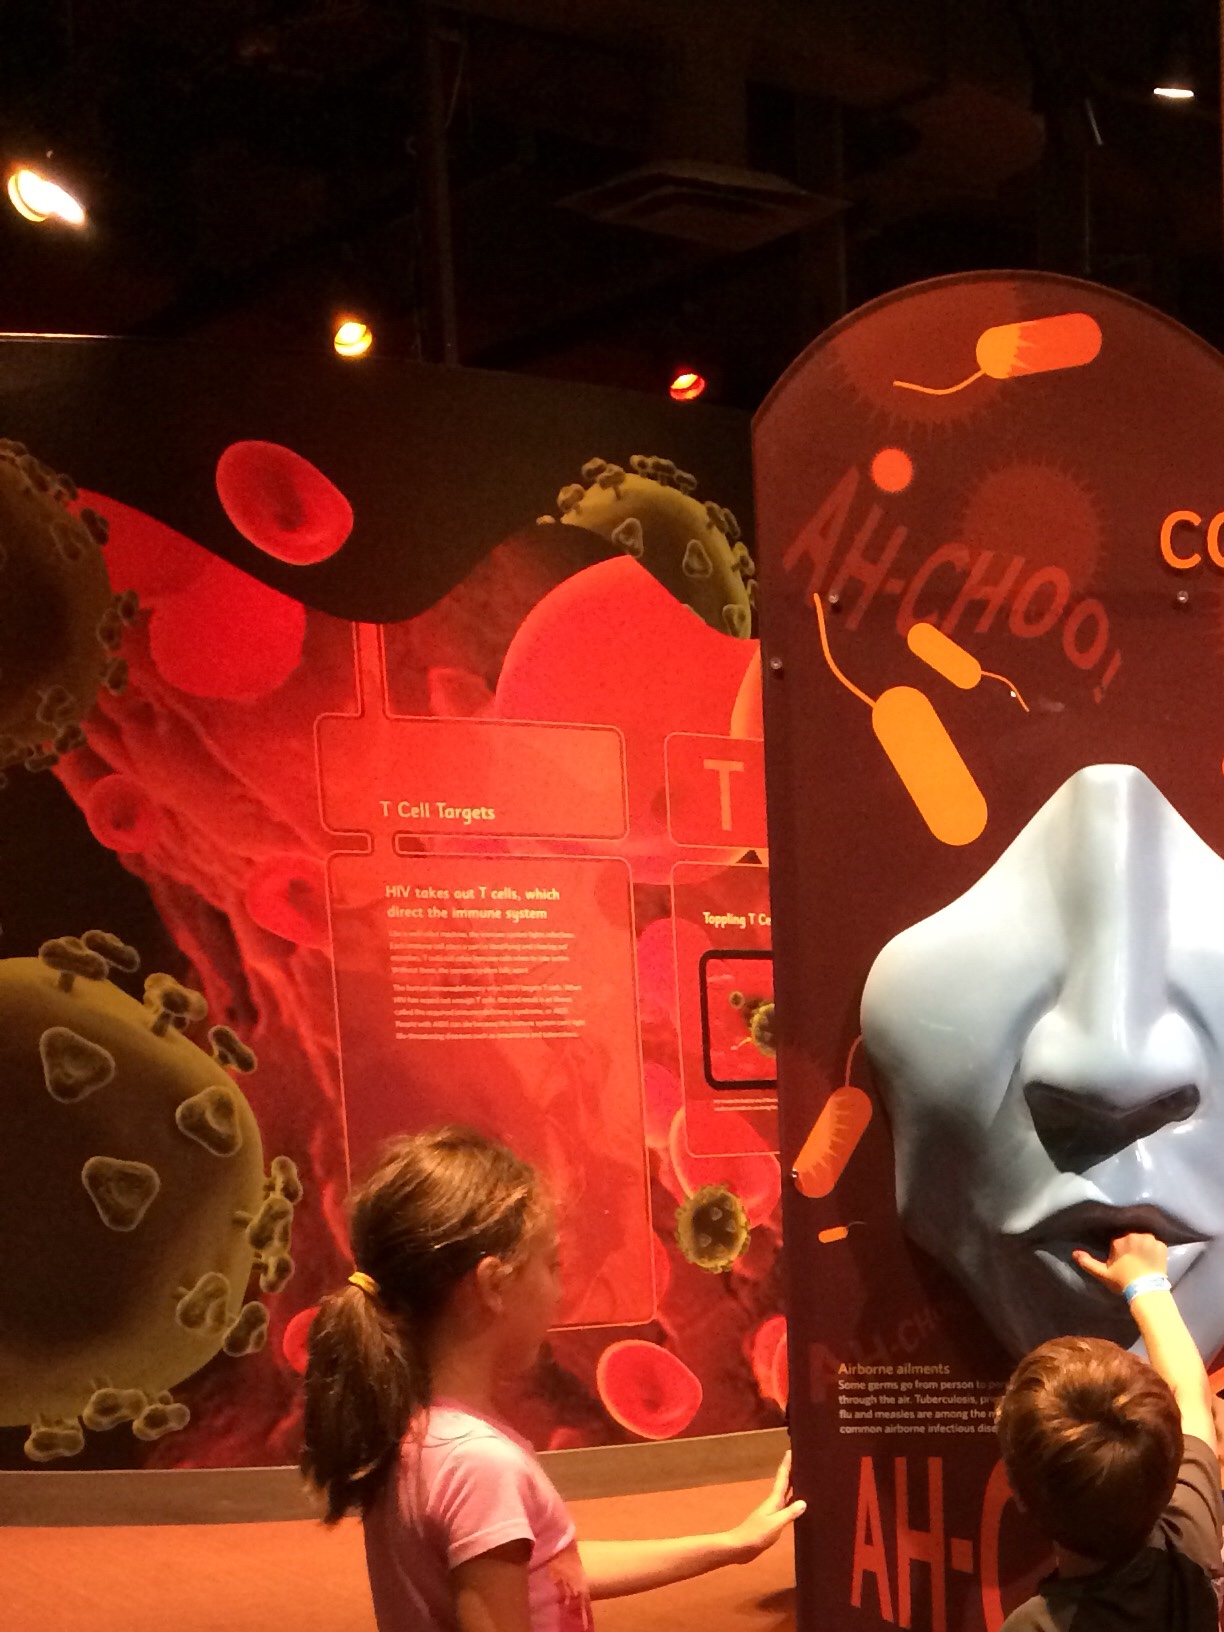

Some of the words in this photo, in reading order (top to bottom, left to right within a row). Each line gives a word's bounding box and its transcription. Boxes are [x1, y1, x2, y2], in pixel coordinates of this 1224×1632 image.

[379, 801, 391, 816] T
[398, 801, 430, 818] Cell
[436, 802, 495, 825] Targets
[385, 885, 411, 898] HIV
[415, 886, 449, 899] takes
[454, 889, 475, 899] out
[478, 886, 487, 899] T
[491, 887, 521, 901] cells,
[525, 888, 560, 900] which
[387, 905, 423, 917] direct
[427, 906, 448, 918] the
[452, 907, 501, 919] immune
[506, 908, 547, 923] system
[703, 912, 746, 929] Toppling
[748, 913, 756, 925] T
[838, 1363, 893, 1375] Airborne
[897, 1363, 950, 1375] ailments
[838, 1380, 866, 1390] Some
[868, 1382, 899, 1392] germs
[900, 1382, 913, 1392] go
[914, 1379, 938, 1389] from
[940, 1381, 974, 1391] person
[838, 1395, 877, 1407] through
[879, 1395, 895, 1405] the
[839, 1409, 852, 1419] flu
[854, 1409, 873, 1419] and
[874, 1409, 915, 1419] measles
[917, 1411, 933, 1419] are
[934, 1410, 968, 1420] among
[970, 1408, 986, 1418] the
[839, 1425, 882, 1434] common
[884, 1423, 926, 1434] airborne
[928, 1423, 975, 1433] infectious
[977, 1423, 998, 1433] dise
